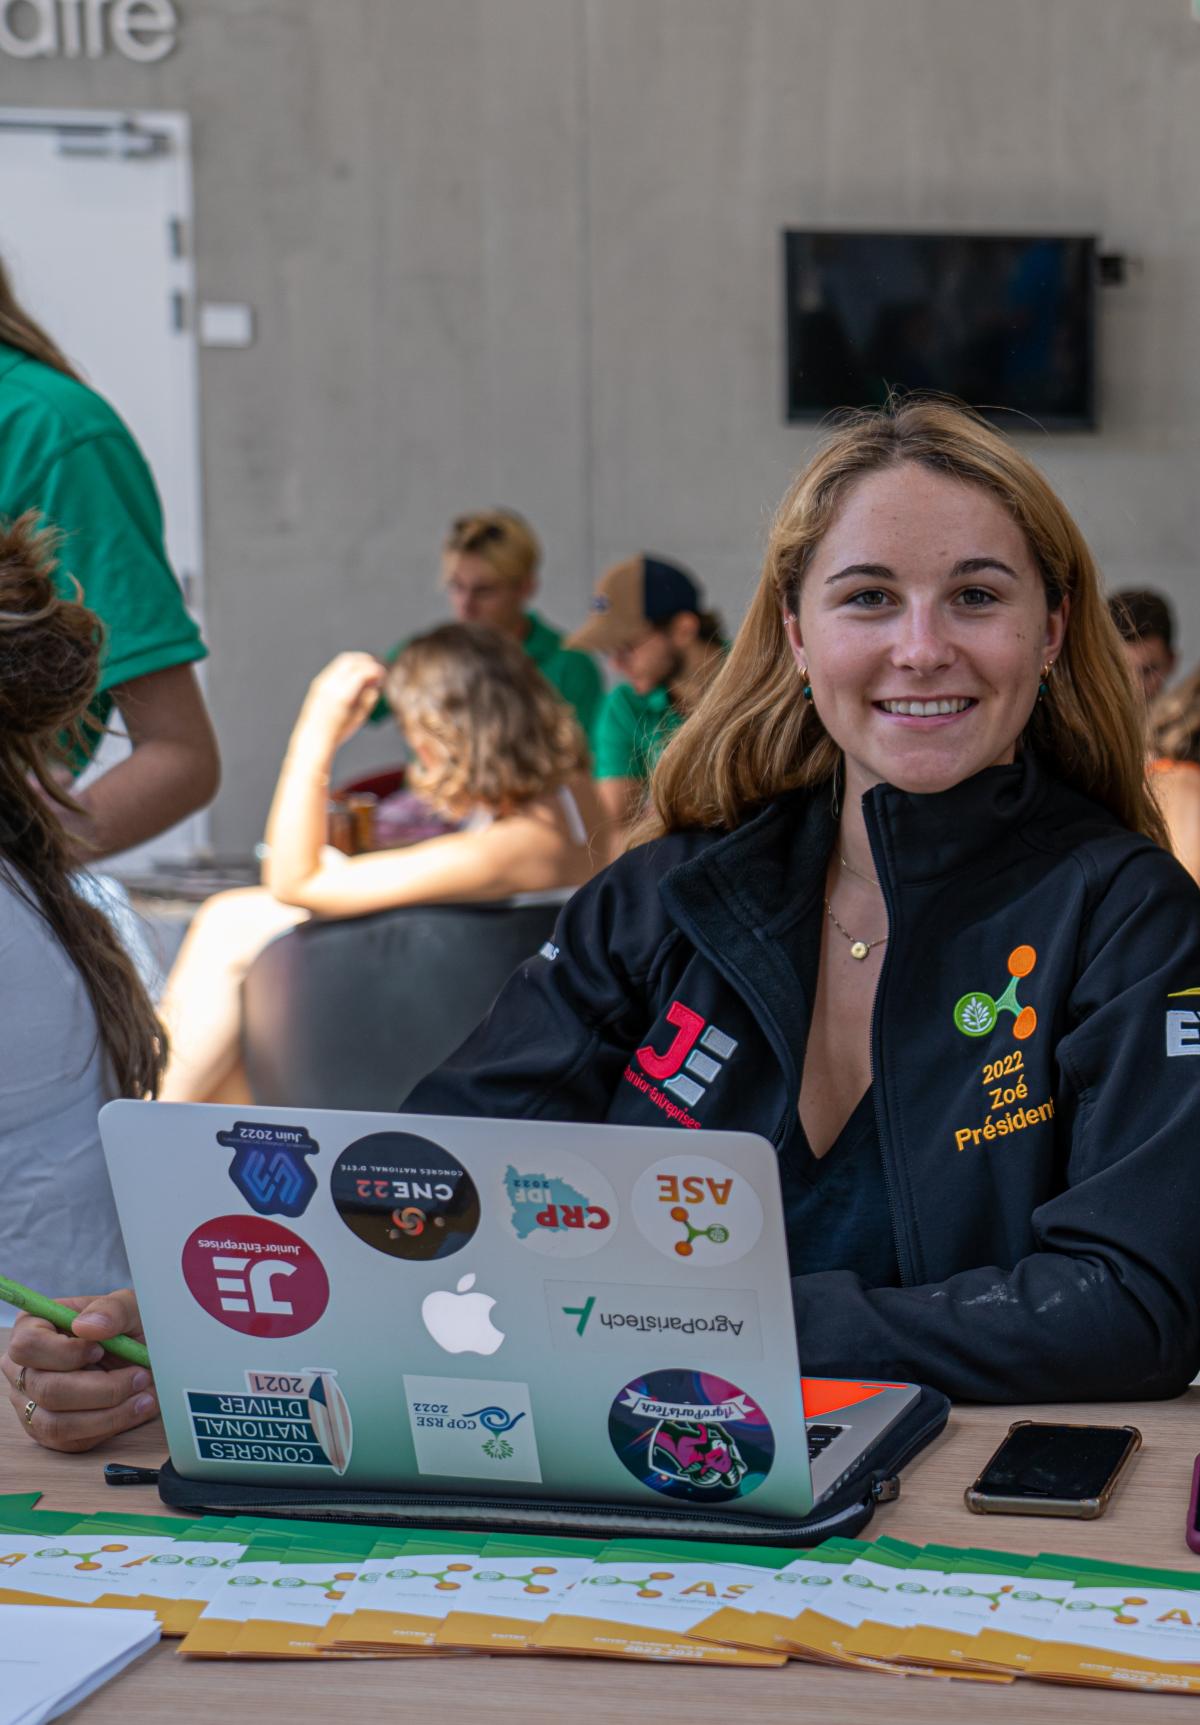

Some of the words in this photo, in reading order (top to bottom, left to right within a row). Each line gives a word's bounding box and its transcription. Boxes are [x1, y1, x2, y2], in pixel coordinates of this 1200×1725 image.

[982, 1050, 1025, 1085] 2022
[988, 1074, 1029, 1111] Zoé
[239, 1128, 273, 1141] 2022
[275, 1131, 303, 1144] Juin
[370, 1165, 417, 1175] NATIONAL
[513, 1179, 550, 1190] 2022
[656, 1175, 734, 1205] ASE
[514, 1188, 552, 1205] IDF
[536, 1204, 611, 1230] CRP
[198, 1239, 301, 1256] Junior-Entreprises
[600, 1312, 744, 1336] AgroParisTech
[254, 1375, 305, 1393] 2021
[219, 1396, 302, 1417] D'HIVER
[413, 1402, 449, 1413] 2022
[641, 1402, 734, 1420] AgroParisTech
[197, 1418, 308, 1441] NATIONAL
[416, 1416, 444, 1428] RSE
[446, 1418, 477, 1430] COP
